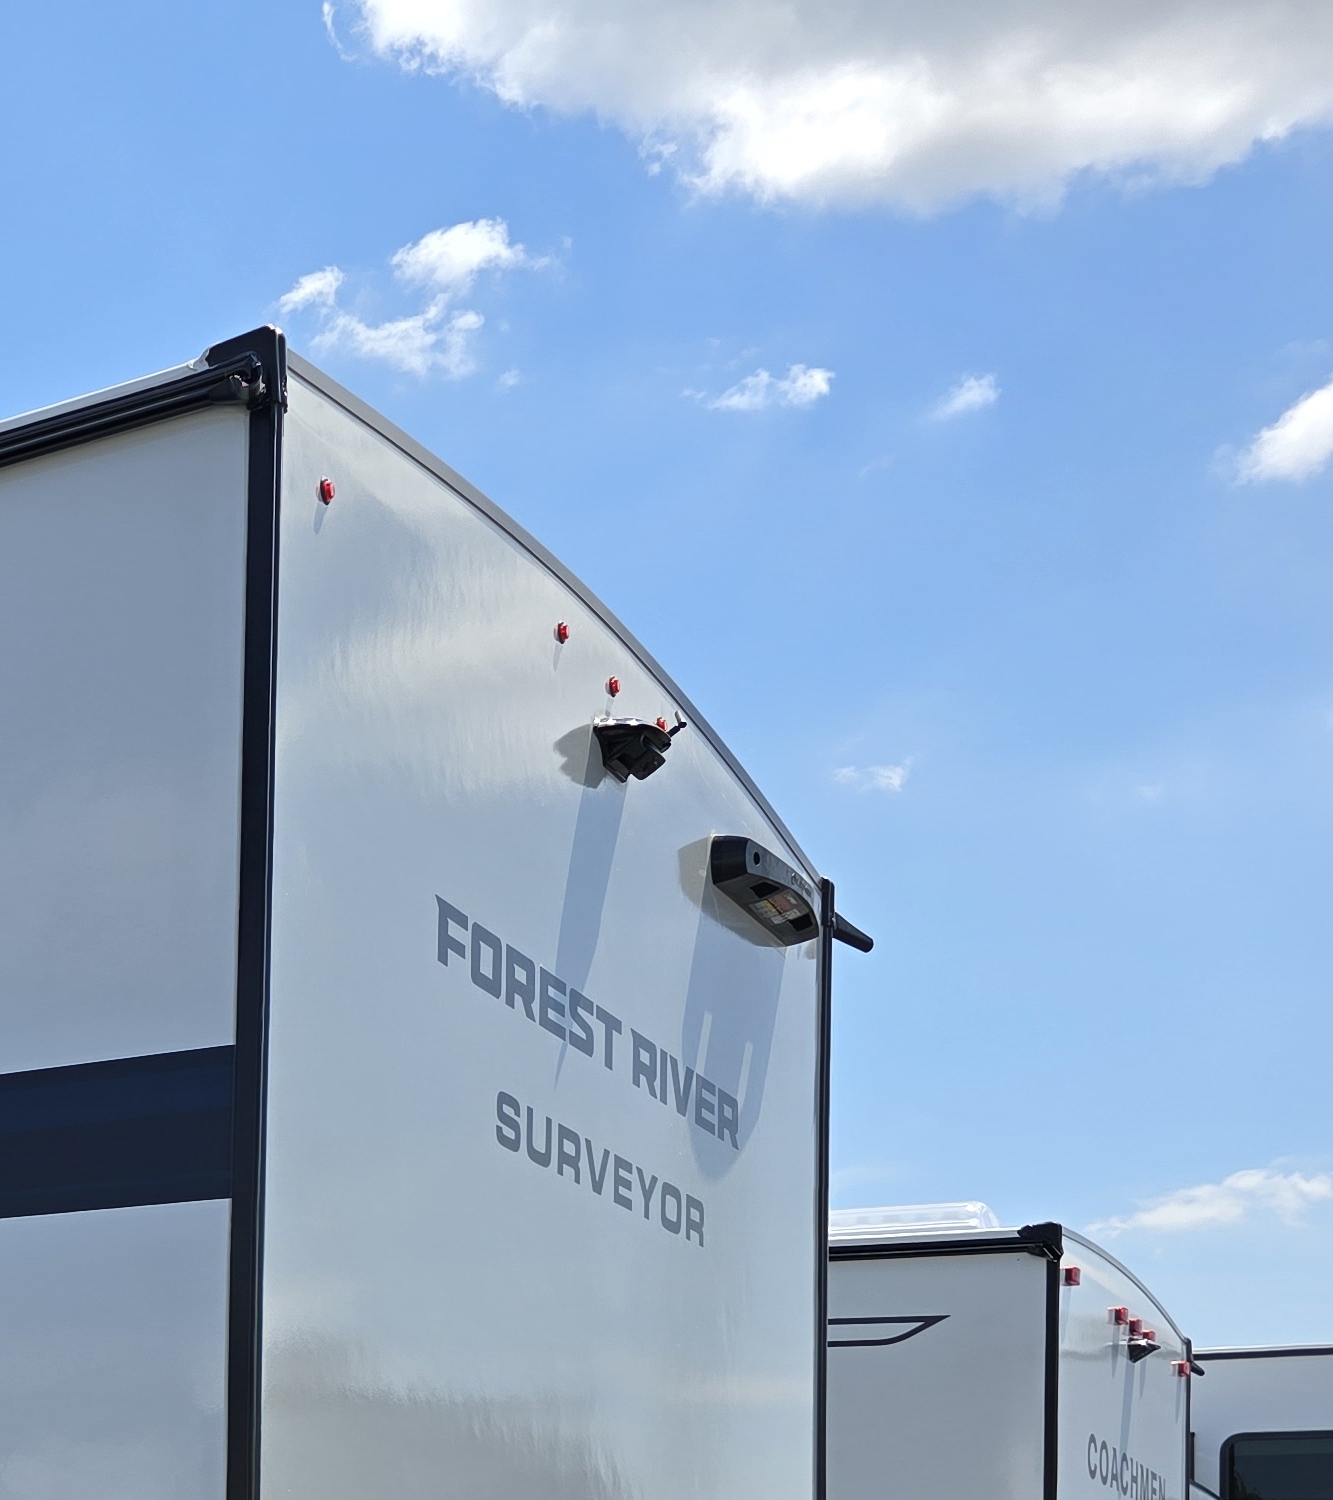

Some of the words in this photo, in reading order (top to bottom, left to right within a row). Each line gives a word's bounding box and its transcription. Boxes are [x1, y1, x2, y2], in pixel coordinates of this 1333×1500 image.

[435, 893, 623, 1072] FOREST
[630, 1027, 740, 1151] RIVER
[495, 1090, 705, 1248] SURVEYOR
